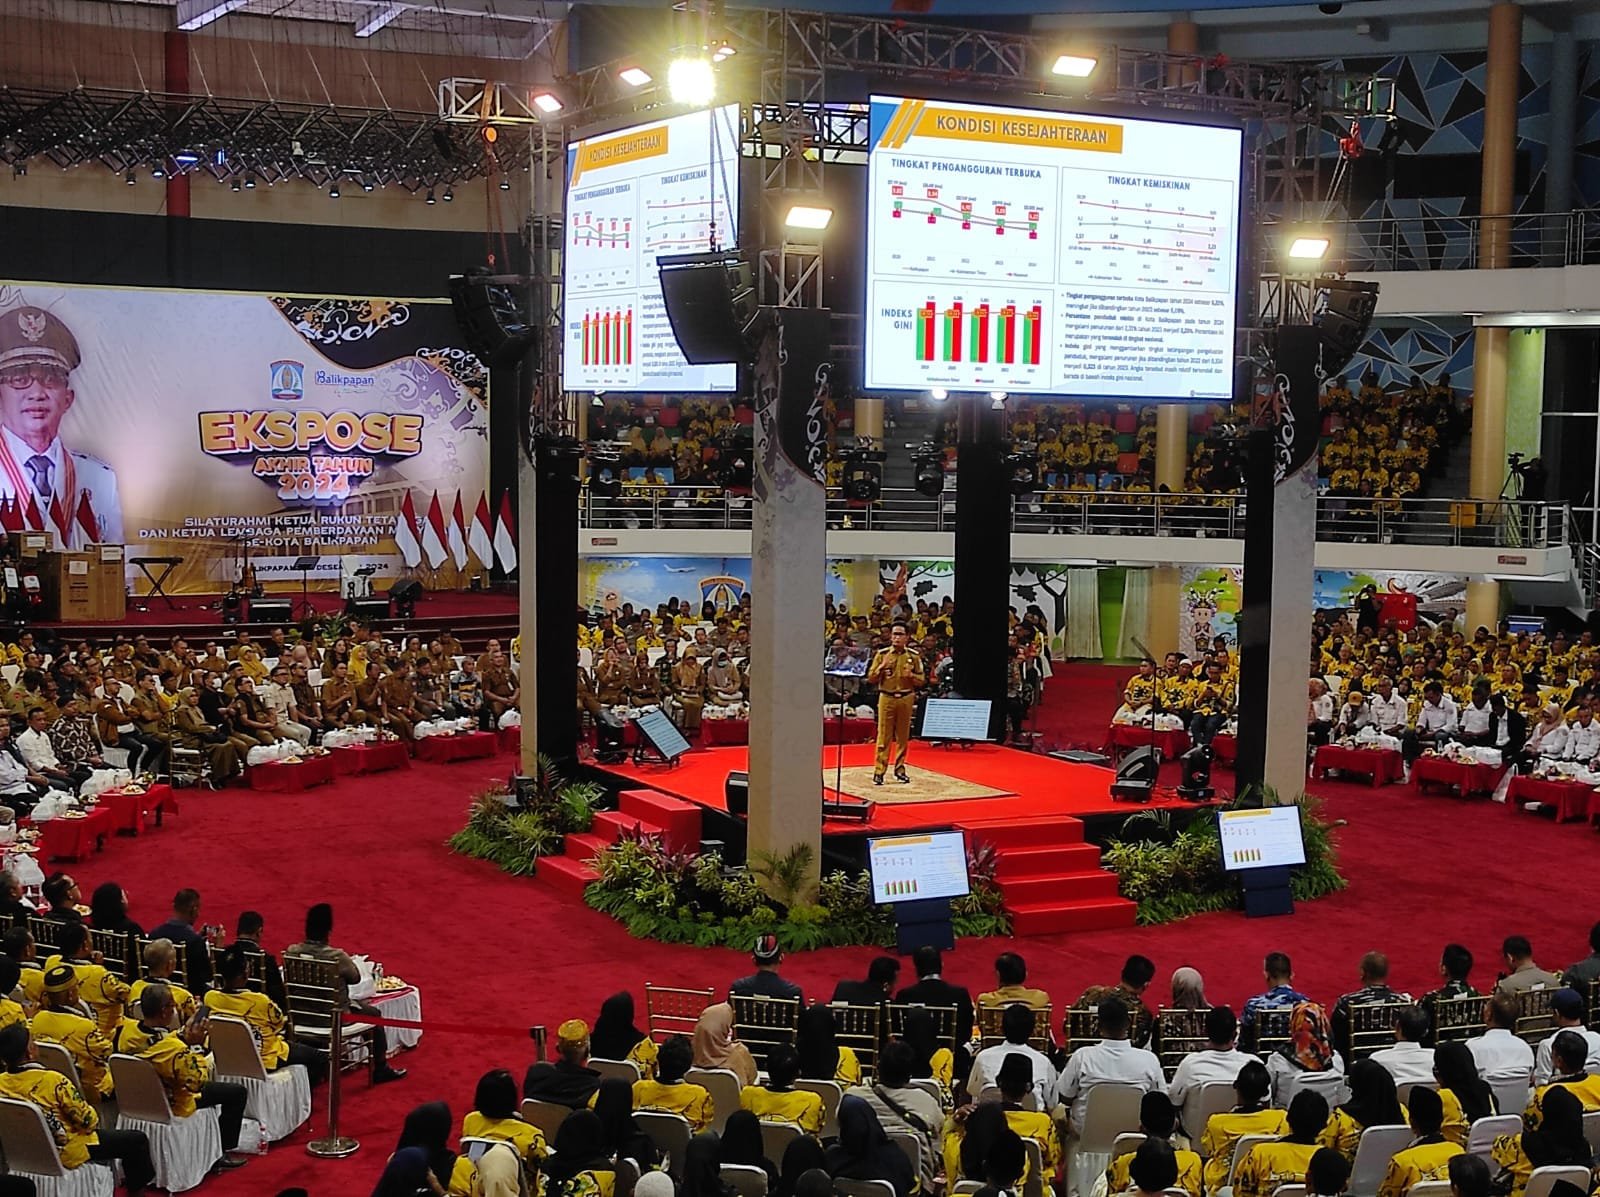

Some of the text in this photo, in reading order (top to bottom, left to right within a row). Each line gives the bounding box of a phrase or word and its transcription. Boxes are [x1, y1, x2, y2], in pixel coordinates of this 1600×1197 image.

[936, 114, 1107, 144] KONDISI KESEJAHTERAAN
[589, 134, 661, 162] KONDISI KESEJAHTERAAN
[891, 158, 1042, 179] TINGKAT PENGANGGURAN TERBUKA
[1108, 175, 1191, 191] TINGKAT KEMISKINAN
[881, 308, 913, 318] INDEKS
[893, 321, 913, 330] GINI
[315, 370, 374, 386] Balikpapan
[199, 410, 423, 455] EKSPOSE
[254, 456, 374, 476] AKHIR TAHUN
[278, 474, 350, 499] 2024
[184, 516, 271, 527] SILATURAHMI
[275, 516, 316, 526] KETUA
[320, 515, 362, 525] RUKUN
[139, 528, 167, 538] DAN
[172, 528, 216, 538] KETUA
[286, 526, 384, 536] PEMBERDAYAAN
[304, 537, 378, 546] BALIKPAPAN
